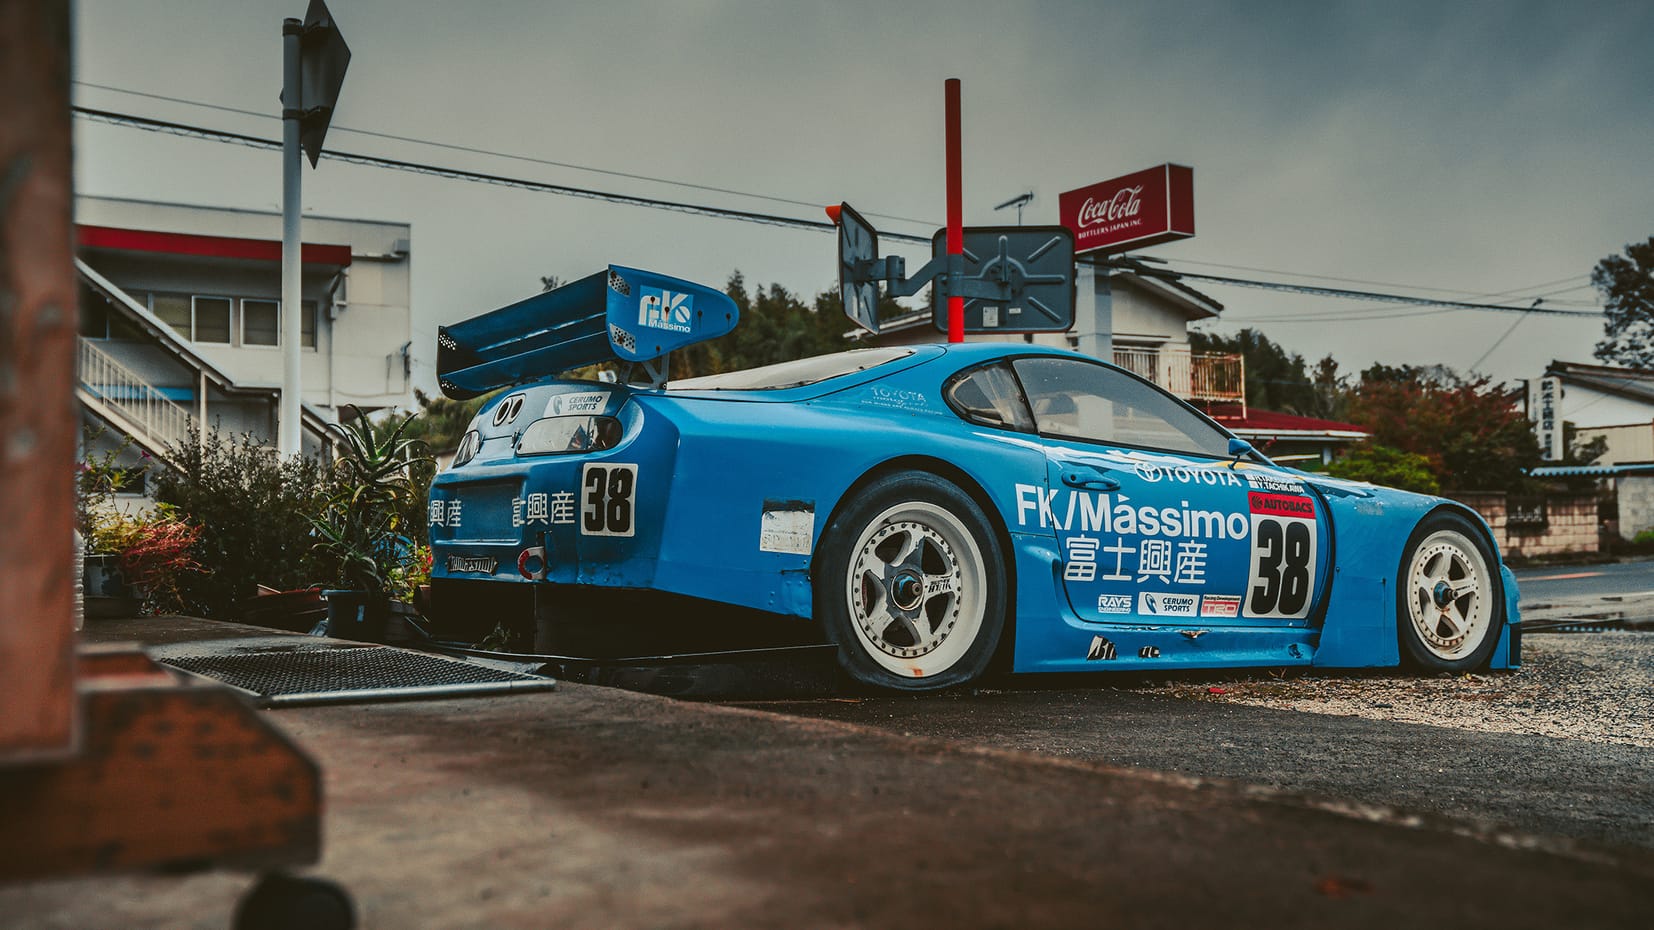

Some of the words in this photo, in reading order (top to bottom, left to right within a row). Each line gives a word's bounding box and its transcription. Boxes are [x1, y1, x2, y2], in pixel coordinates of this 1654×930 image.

[1078, 227, 1109, 239] BOTTLERS
[1110, 222, 1129, 232] JAPAN
[568, 395, 603, 404] CERUMO
[568, 402, 597, 411] SPORTS
[1164, 467, 1243, 488] TOYOTA
[584, 467, 634, 533] 38
[1263, 499, 1313, 513] AUTOBACS
[1063, 534, 1208, 585] 富士興産
[1250, 519, 1311, 616] 38
[1098, 596, 1132, 607] RAYS
[1162, 597, 1194, 606] CERUMO
[1203, 604, 1237, 615] TRD
